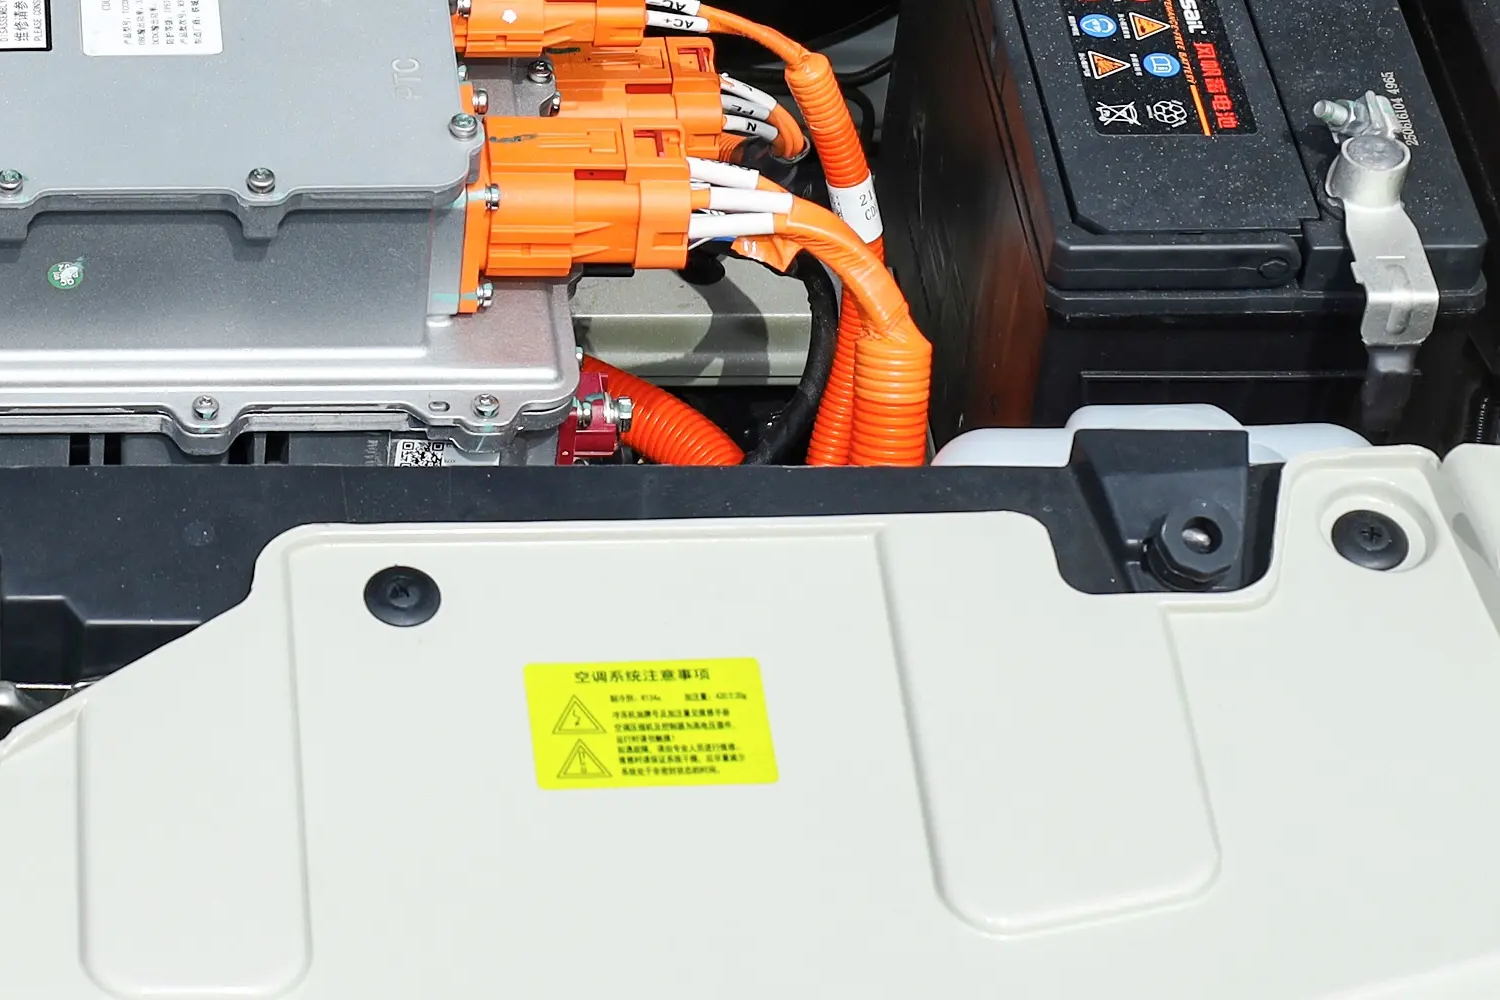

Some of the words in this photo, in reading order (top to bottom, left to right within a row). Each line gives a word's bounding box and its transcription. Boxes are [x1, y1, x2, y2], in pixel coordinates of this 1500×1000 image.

[663, 16, 695, 29] AC+
[1380, 71, 1400, 95] 4965
[574, 668, 711, 684] 空调系统注意事项
